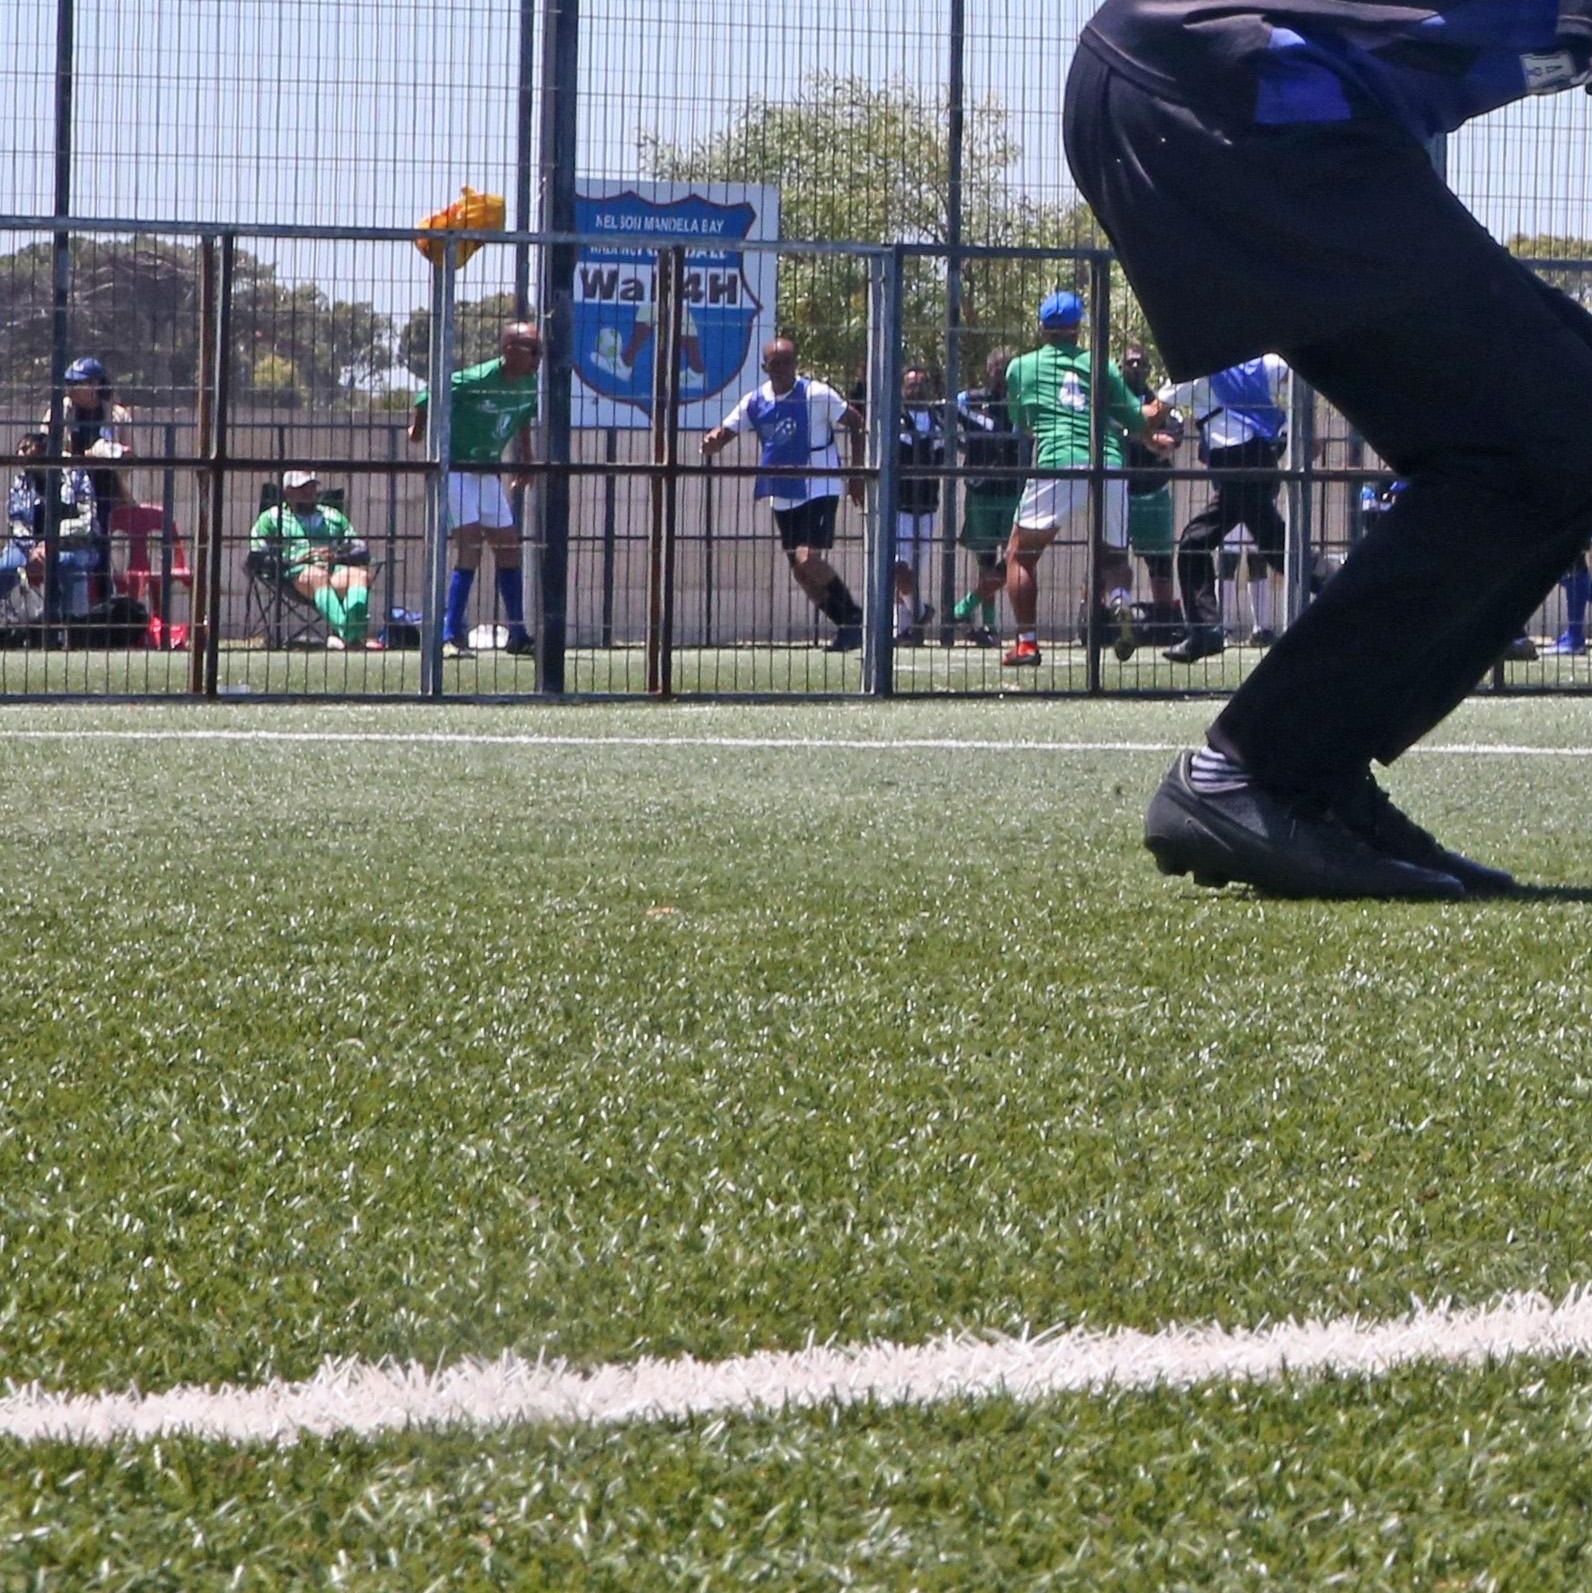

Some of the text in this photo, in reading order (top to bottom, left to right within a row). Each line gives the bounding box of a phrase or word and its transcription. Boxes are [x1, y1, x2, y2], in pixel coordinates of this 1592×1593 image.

[642, 215, 700, 233] MANDELA
[701, 218, 726, 233] BAY
[579, 267, 738, 305] Wa4H
